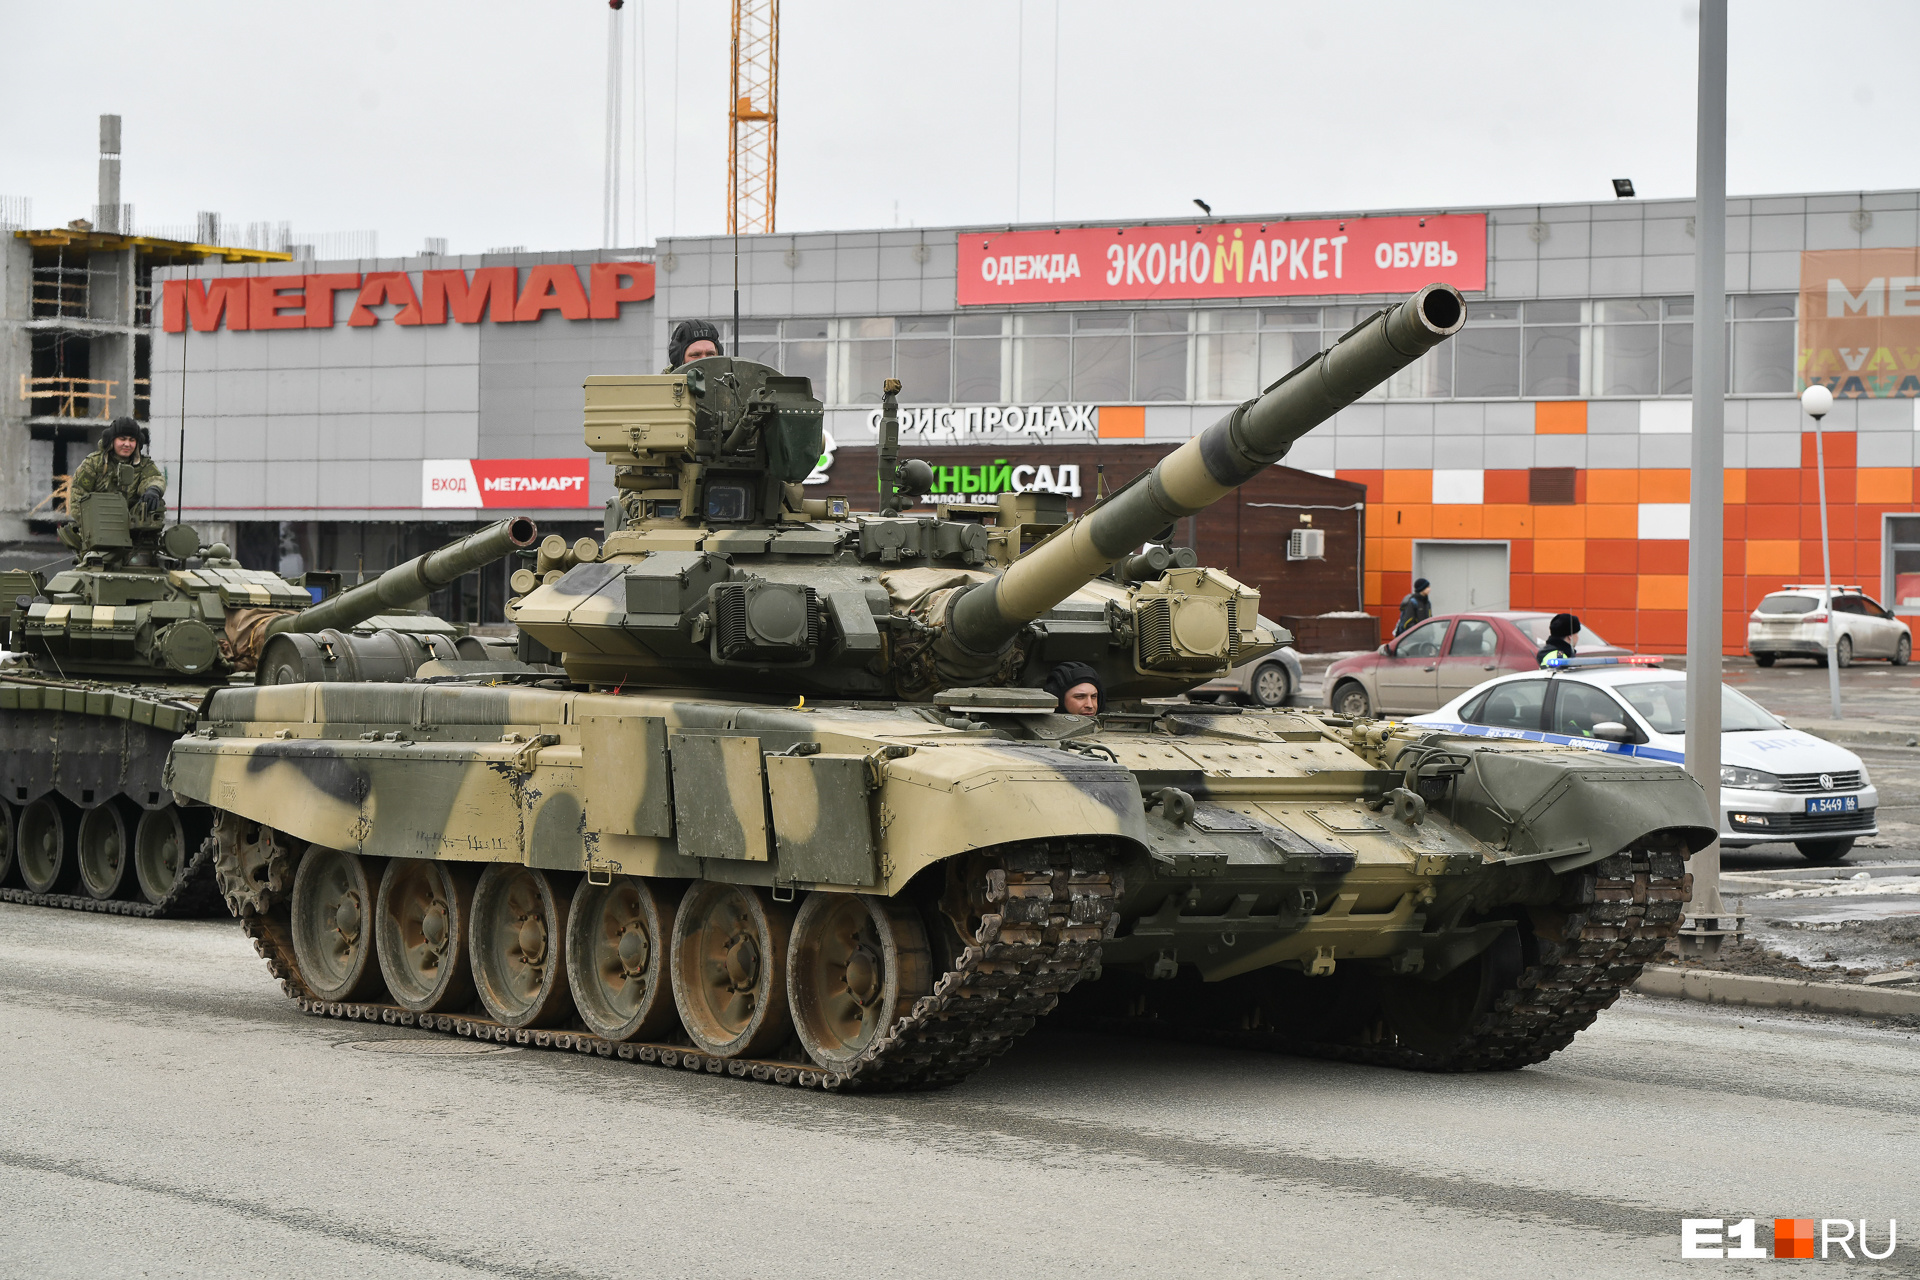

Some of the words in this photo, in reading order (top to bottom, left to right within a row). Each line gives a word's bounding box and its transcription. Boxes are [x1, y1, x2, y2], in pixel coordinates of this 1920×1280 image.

[982, 253, 1081, 285] ОДЕЖДА
[1106, 228, 1348, 286] ЭКОНОМАРКЕТ
[1375, 240, 1458, 269] ОБУВЬ
[163, 262, 655, 333] МЕГАМАР
[1827, 276, 1920, 318] МЕ
[965, 405, 1097, 436] ПРОДАЖ
[432, 478, 467, 493] ВХОД
[484, 476, 584, 492] МЕГАМАРТ
[921, 492, 966, 505] ЖИЛОЙ
[970, 494, 999, 505] КОМ
[1568, 739, 1609, 751] ПОЛИЦИЯ
[1749, 738, 1815, 751] ДПС
[1820, 798, 1842, 812] 5449
[1846, 796, 1856, 806] 66
